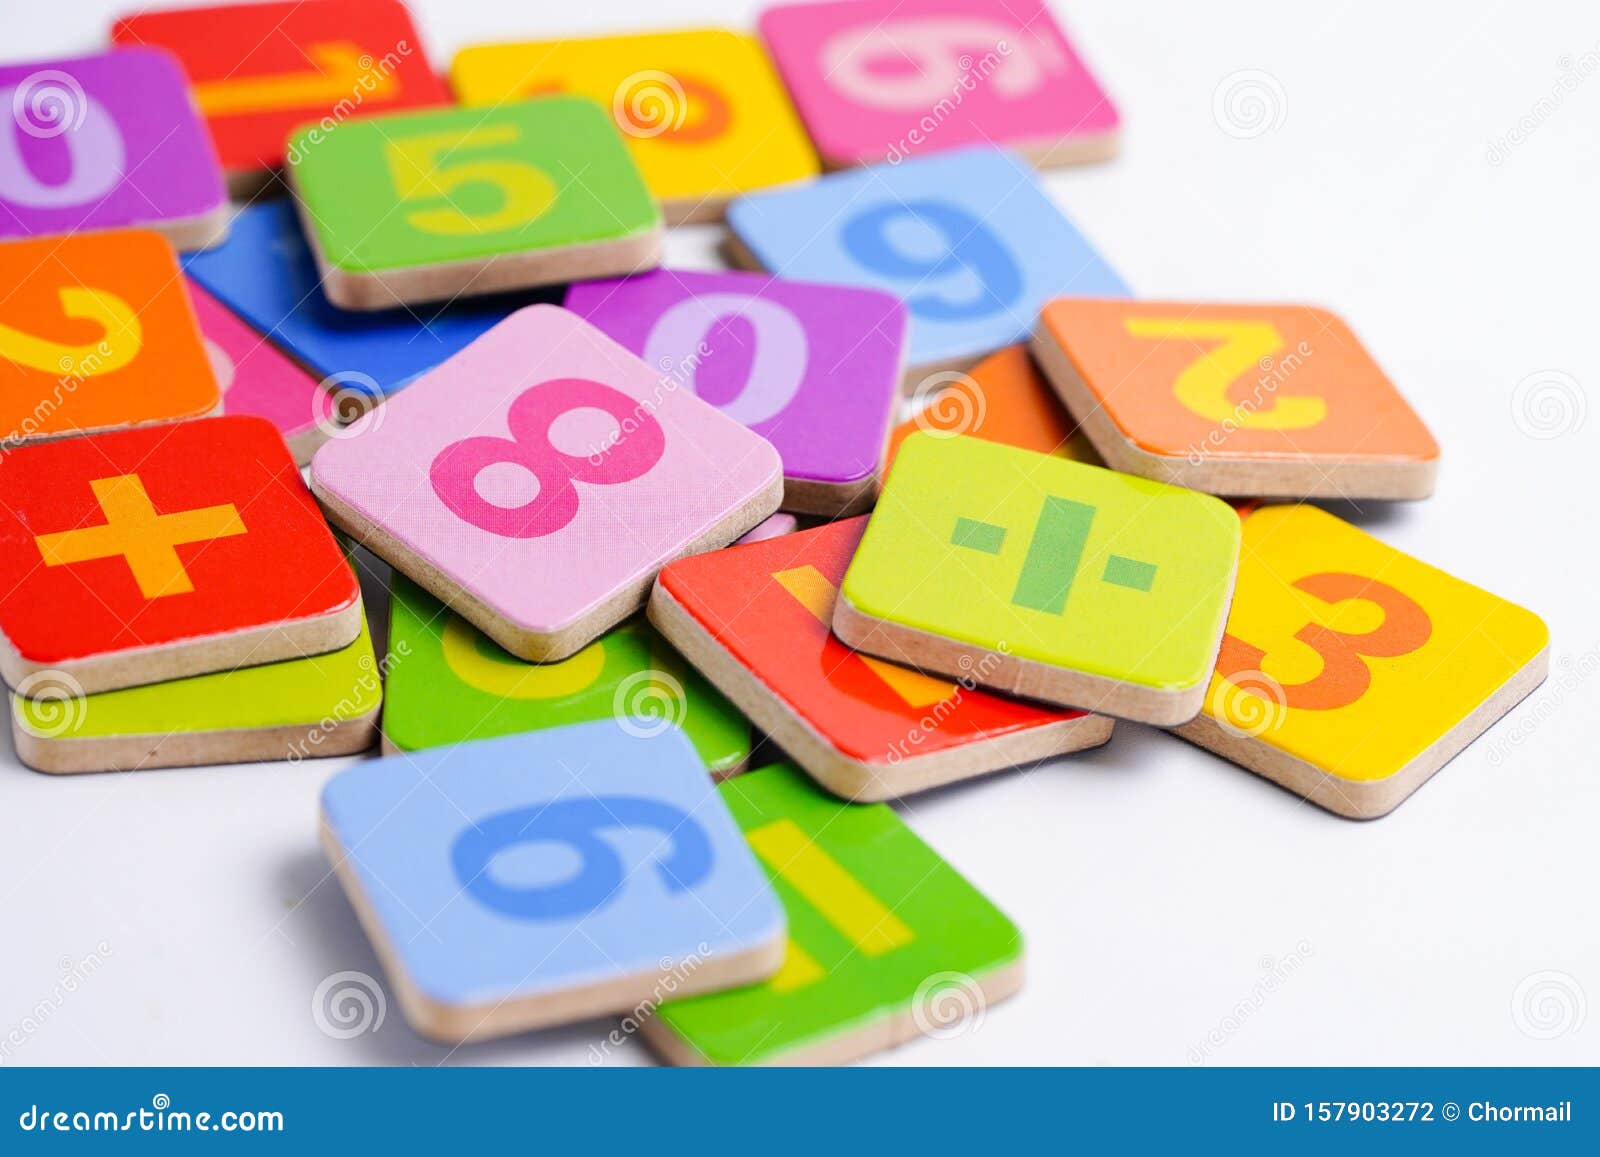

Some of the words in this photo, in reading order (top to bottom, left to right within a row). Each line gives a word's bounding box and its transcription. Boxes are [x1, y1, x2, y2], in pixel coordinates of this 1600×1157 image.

[385, 125, 557, 235] 5
[643, 293, 809, 427] 0
[1123, 319, 1327, 430] 2
[430, 378, 666, 539] 8
[36, 473, 248, 599] +
[1217, 572, 1433, 712] 3
